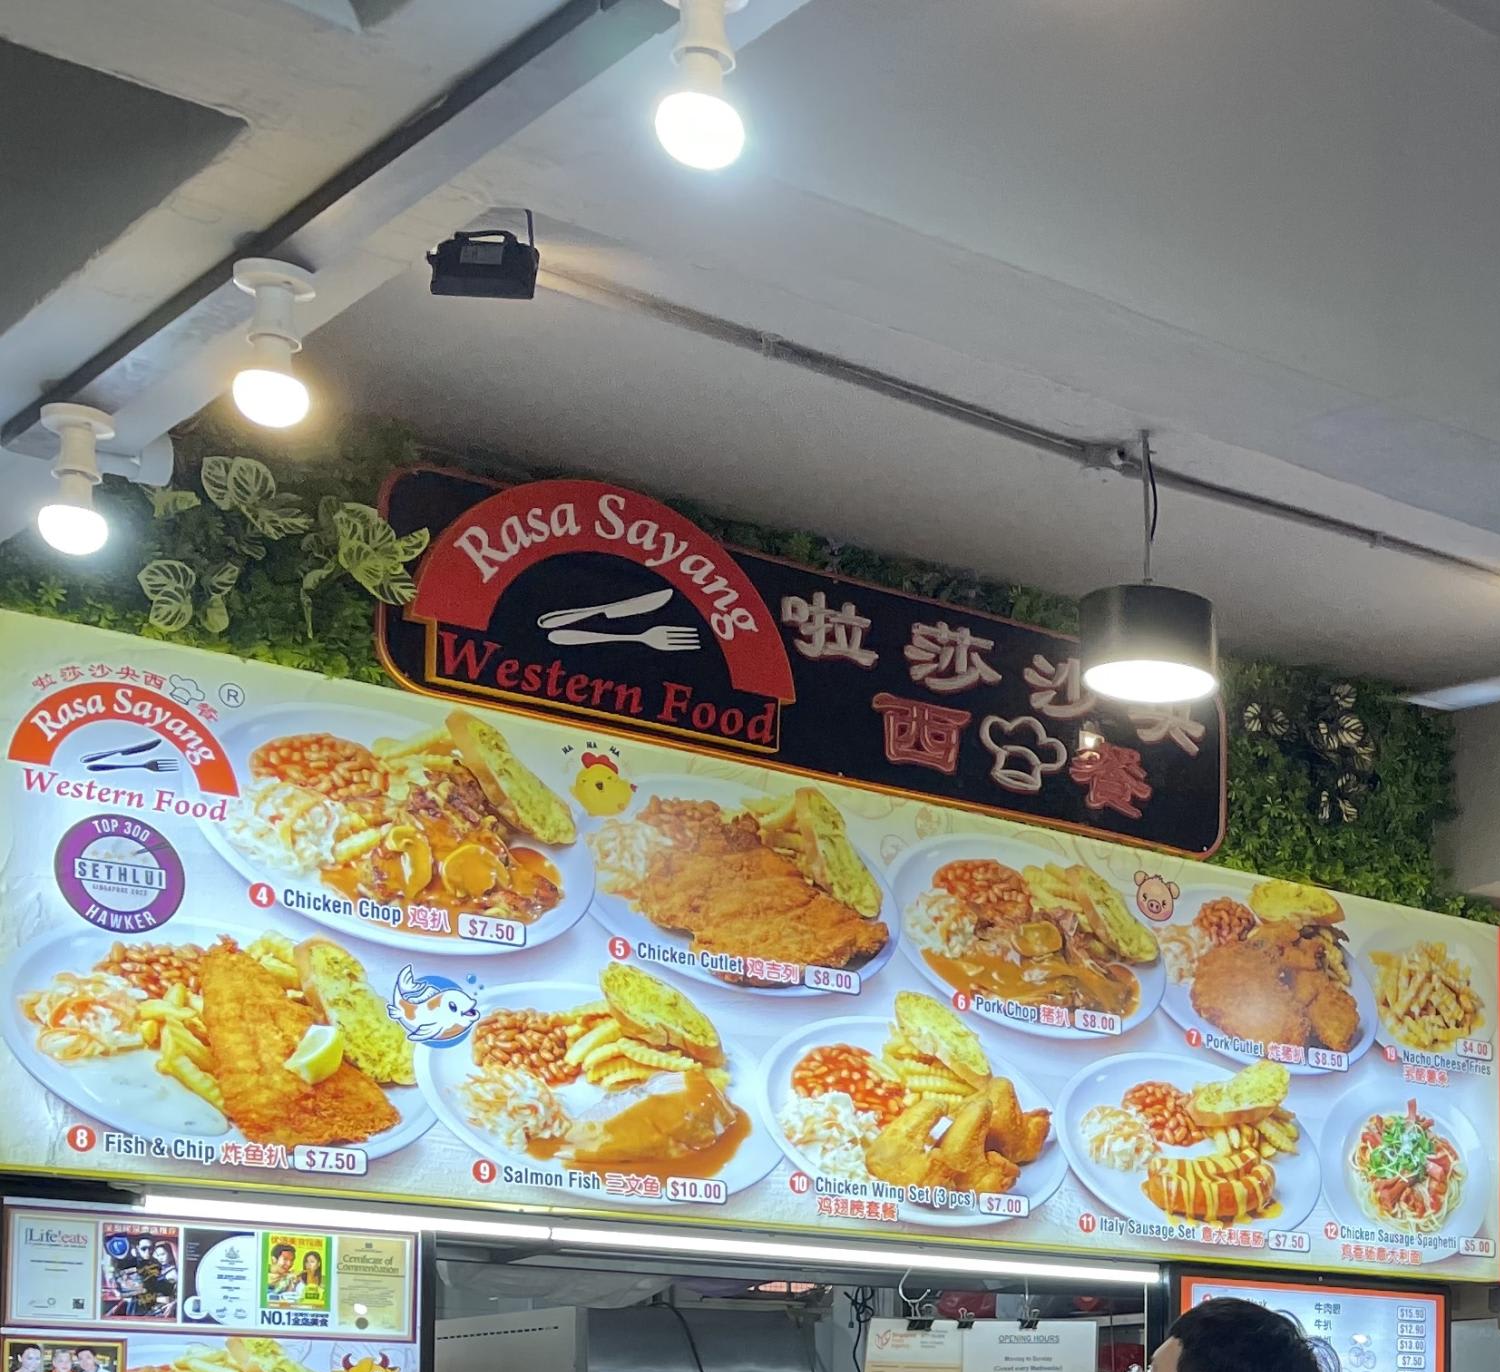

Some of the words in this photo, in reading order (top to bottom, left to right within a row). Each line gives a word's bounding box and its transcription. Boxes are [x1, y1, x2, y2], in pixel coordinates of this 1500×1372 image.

[454, 503, 580, 583] Rasa
[595, 494, 758, 641] Sayang
[439, 631, 644, 714] Western
[657, 682, 777, 744] Food
[30, 694, 106, 742] Rasa
[113, 688, 216, 765] Sayang
[872, 691, 972, 776] 西
[23, 768, 144, 808] Western
[152, 790, 228, 822] Food
[92, 819, 119, 834] TOP
[123, 821, 151, 842] 300
[78, 861, 163, 886] SETHLUI
[85, 904, 157, 930] HAWKER
[255, 887, 268, 904] 4
[283, 889, 352, 916] Chicken
[359, 901, 401, 925] Chop
[409, 907, 450, 931] 鸡扒
[469, 920, 515, 941] $7.50
[615, 940, 625, 957] 5
[637, 942, 695, 966] Chicken
[701, 953, 743, 973] Cutlet
[748, 959, 799, 983] 鸡吉列
[814, 970, 851, 989] $8.00
[957, 994, 966, 1009] 6
[976, 997, 1005, 1016] Pork
[1007, 1001, 1036, 1021] Chop
[1041, 1006, 1070, 1027] 猪扒
[1083, 1013, 1114, 1030] $8.00
[1190, 1030, 1198, 1044] 7
[1206, 1034, 1231, 1050] Pork
[1233, 1038, 1264, 1056] Cutlet
[1463, 1041, 1488, 1055] $4.00
[1314, 1053, 1343, 1067] $8.50
[1403, 1050, 1431, 1065] Nacho
[1434, 1054, 1468, 1071] Cheese
[1469, 1061, 1491, 1075] Fries
[76, 1129, 87, 1148] 8
[105, 1134, 145, 1155] Fish
[152, 1138, 166, 1156] &
[173, 1139, 215, 1162] Chip
[221, 1145, 288, 1169] 炸鱼扒
[305, 1152, 356, 1171] $7.50
[480, 1163, 489, 1179] 9
[504, 1166, 563, 1186] Salmon
[569, 1172, 600, 1190] Fish
[606, 1174, 661, 1197] 三文鱼
[670, 1180, 721, 1199] $10.00
[792, 1174, 807, 1192] 10
[816, 1176, 867, 1196] Chicken
[872, 1182, 904, 1202] Wing
[909, 1187, 930, 1202] Set
[950, 1190, 975, 1208] pcs)
[987, 1197, 1021, 1214] $7.00
[1082, 1216, 1094, 1231] 11
[1100, 1217, 1126, 1236] Italy
[1129, 1219, 1174, 1239] Sausage
[1178, 1225, 1195, 1240] Set
[1326, 1224, 1338, 1239] 12
[1340, 1226, 1375, 1241] Chicken
[1378, 1230, 1415, 1245] Sausage
[1417, 1234, 1457, 1250] Spaghetti
[1465, 1240, 1490, 1254] $5.00
[1275, 1235, 1304, 1249] $7.50
[261, 1311, 291, 1325] NO.1
